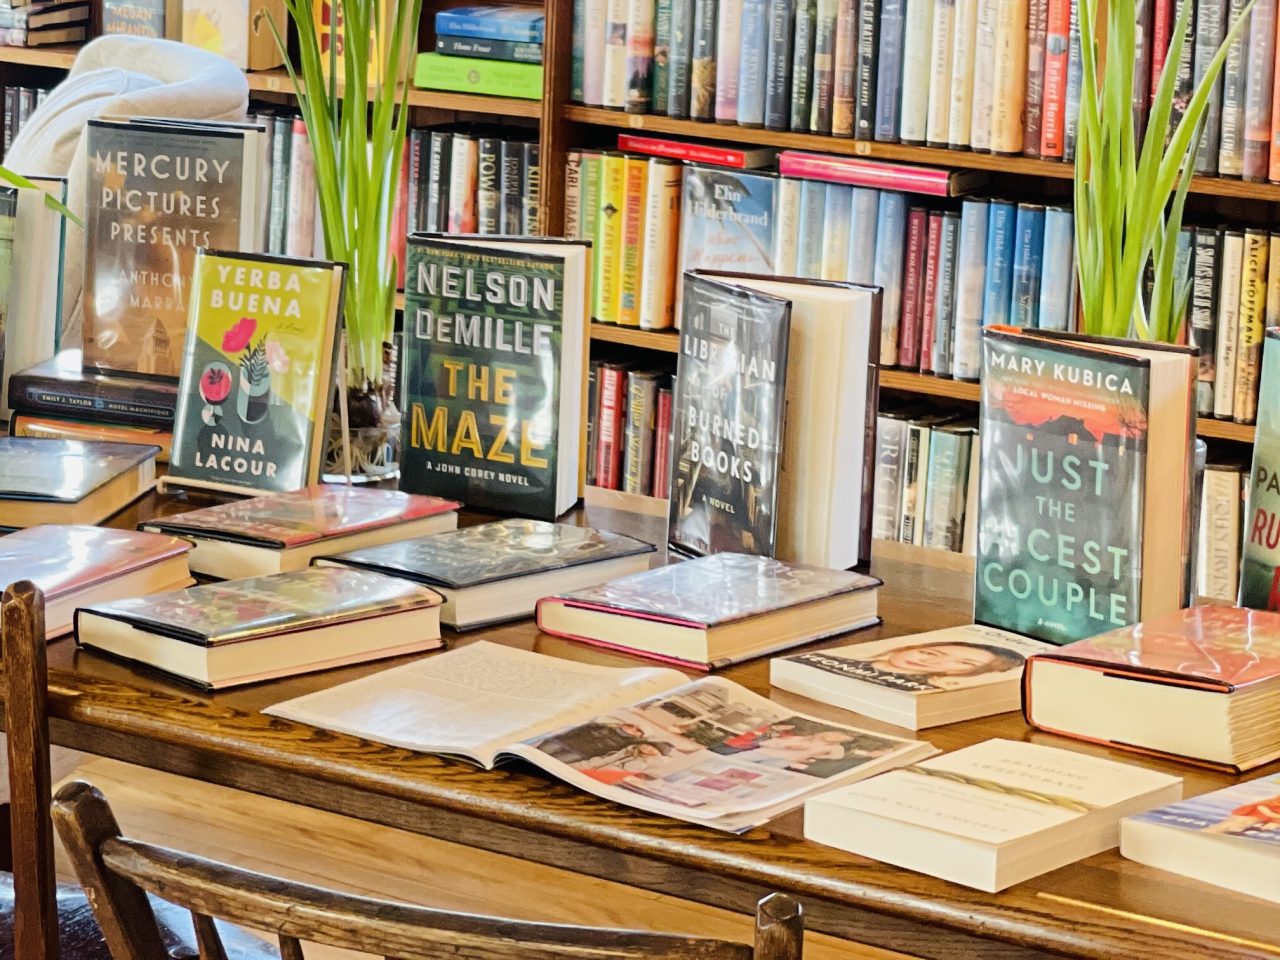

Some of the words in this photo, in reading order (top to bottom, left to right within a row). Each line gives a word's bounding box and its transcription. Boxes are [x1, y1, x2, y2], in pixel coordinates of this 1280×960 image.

[111, 6, 153, 21] MEGAN
[773, 17, 784, 42] road
[862, 10, 873, 22] OF
[1209, 4, 1220, 38] JOHN
[453, 41, 471, 51] Home
[472, 43, 491, 53] Front
[860, 23, 873, 58] NATURE
[776, 55, 785, 94] KRISTIN
[861, 64, 870, 80] JANE
[1048, 60, 1063, 99] Robert
[860, 82, 869, 107] HARPER
[1045, 102, 1060, 139] Harris
[95, 149, 230, 184] MERCURY
[479, 153, 497, 209] POWER
[509, 156, 520, 195] JOSEPH
[567, 158, 580, 187] CARL
[102, 187, 221, 219] PICTURES
[527, 165, 541, 209] KILLER
[714, 183, 741, 202] Elin
[565, 191, 578, 239] HIAASE
[995, 210, 1007, 227] Elin
[110, 222, 211, 249] PRESENTS
[603, 224, 614, 251] CARL
[992, 229, 1006, 283] Hilderbrand
[1249, 238, 1259, 274] ALICE
[217, 265, 302, 293] YERBA
[417, 262, 555, 311] NELSON
[601, 255, 613, 304] HIAASEN
[130, 295, 185, 313] MARRA
[210, 290, 302, 318] BUENA
[1245, 279, 1257, 346] HOFFMAN
[719, 322, 735, 338] THE
[684, 334, 776, 382] LIBRIAN
[991, 351, 1046, 376] MARY
[1053, 364, 1133, 395] KUBICA
[443, 359, 517, 405] THE
[712, 388, 726, 400] OF
[69, 398, 92, 406] TAYLOR
[108, 403, 128, 411] HOTEL
[130, 406, 170, 416] MAGNIFIQUE
[1013, 385, 1038, 399] LOCAL
[1040, 391, 1071, 406] WOMAN
[1073, 397, 1106, 413] MISSING
[411, 404, 548, 469] MAZE
[688, 405, 759, 449] BURNED
[211, 433, 266, 455] NINA
[195, 452, 278, 478] LACOUR
[427, 461, 433, 470] A
[436, 463, 461, 475] JOHN
[465, 466, 496, 481] COREY
[498, 471, 529, 487] NOVEL
[690, 441, 753, 483] BOOKS
[1010, 444, 1110, 496] JUST
[702, 494, 708, 504] A
[709, 496, 735, 514] NOVEL
[1035, 495, 1076, 522] THE
[996, 520, 1128, 580] CEST
[983, 562, 1127, 626] COUPLE
[800, 653, 878, 678] YEONMI
[878, 675, 933, 692] PARK
[972, 762, 1086, 791] SWEETGRASS
[1000, 757, 1089, 782] BRAIDING
